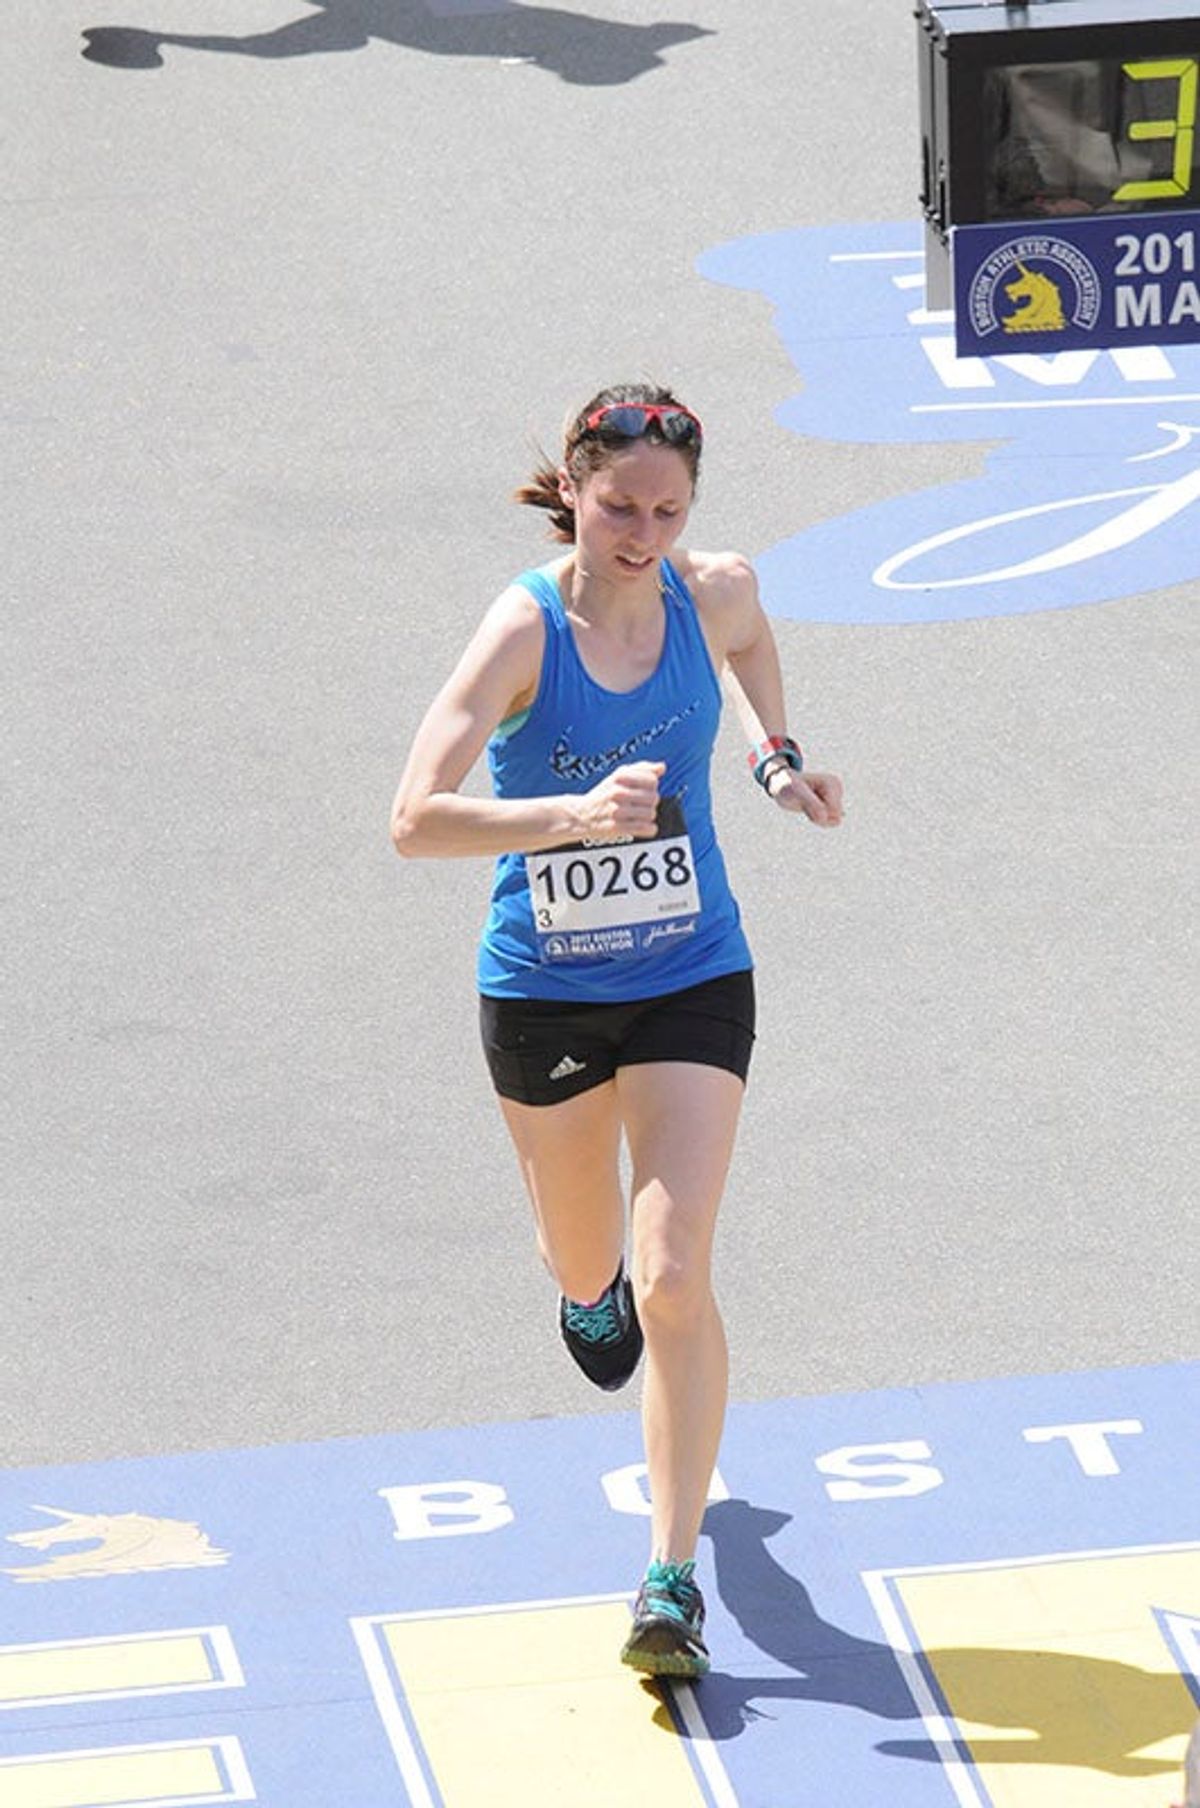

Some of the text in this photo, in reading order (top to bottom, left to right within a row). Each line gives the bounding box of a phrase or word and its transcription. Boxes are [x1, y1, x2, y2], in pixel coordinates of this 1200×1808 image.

[1112, 58, 1198, 200] 3
[1114, 230, 1195, 277] 201
[974, 274, 993, 329] BOSTON
[987, 241, 1051, 276] ATHLETIC
[1115, 281, 1200, 328] MA
[537, 846, 692, 904] 10268
[538, 908, 553, 928] 3
[570, 939, 635, 954] MARATHON
